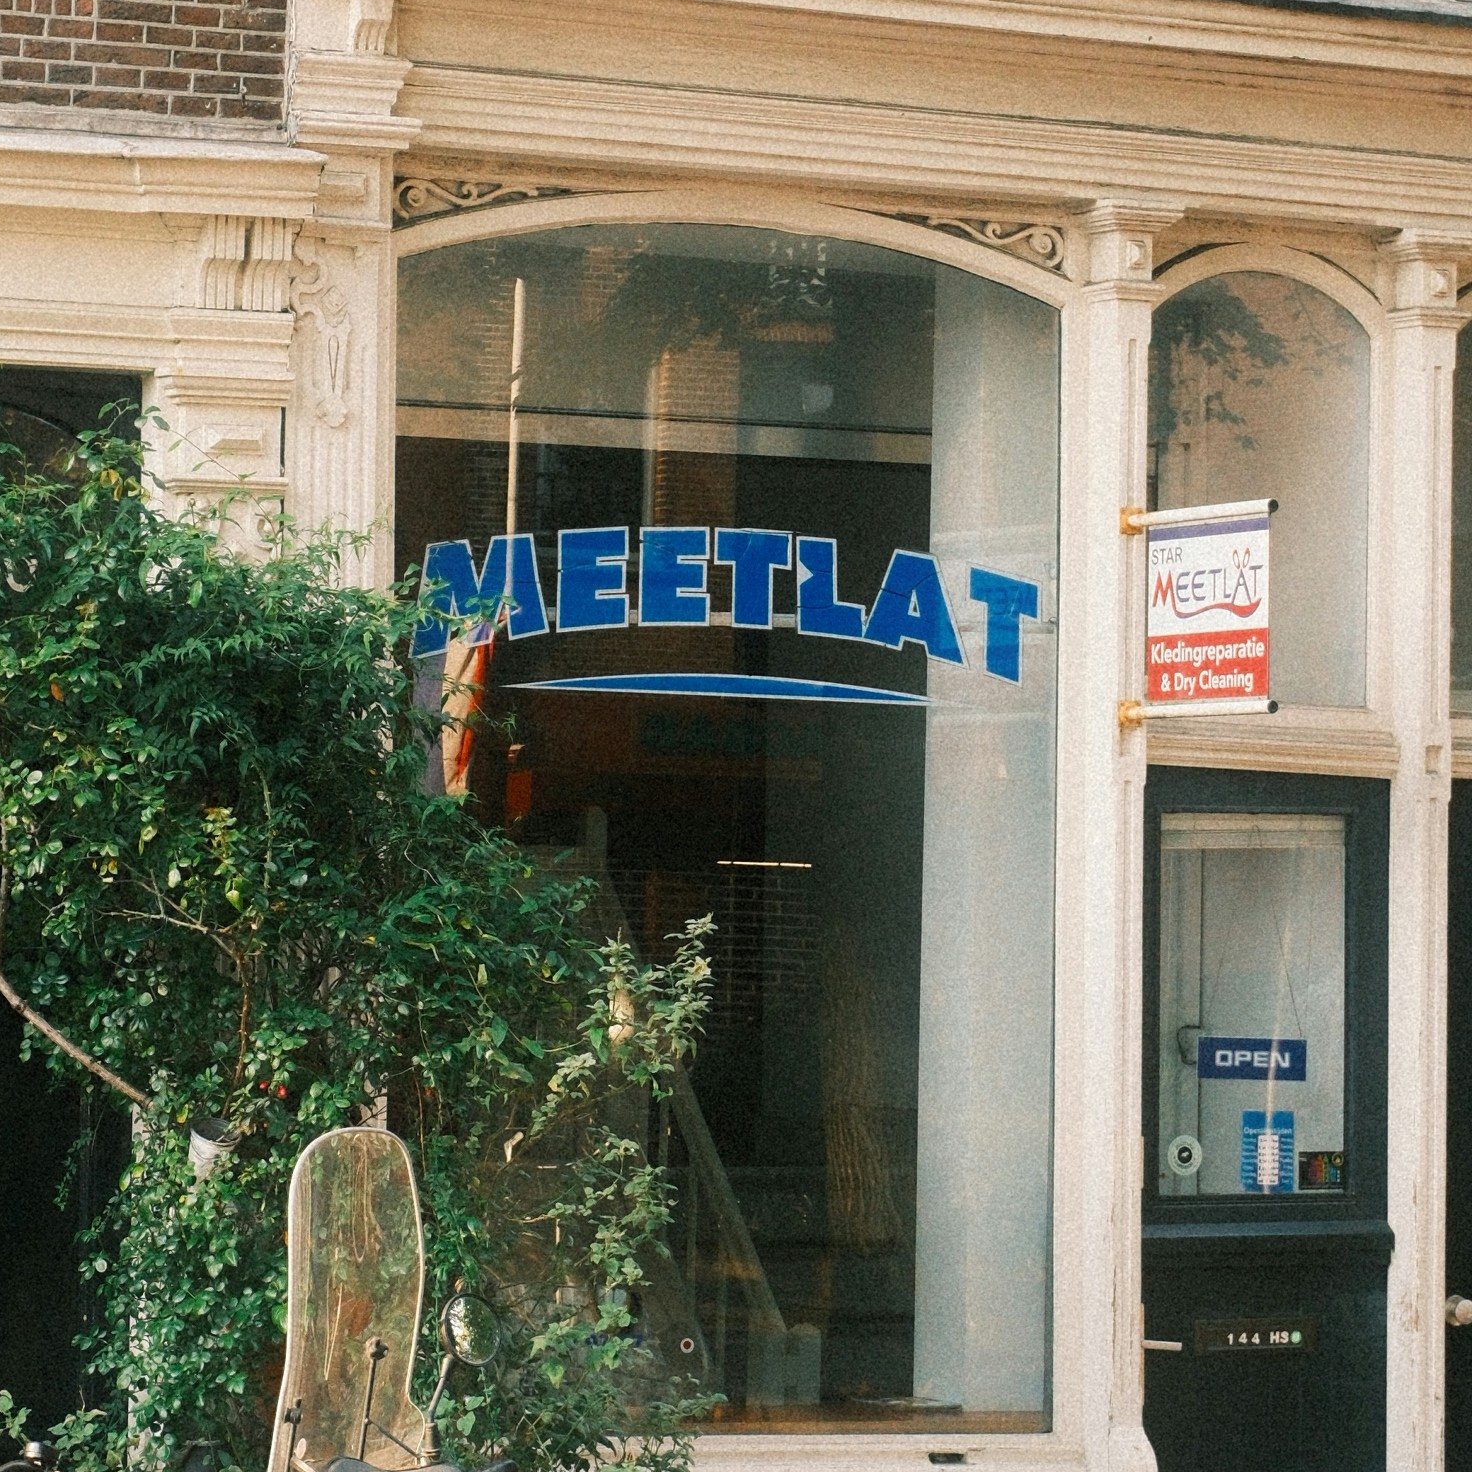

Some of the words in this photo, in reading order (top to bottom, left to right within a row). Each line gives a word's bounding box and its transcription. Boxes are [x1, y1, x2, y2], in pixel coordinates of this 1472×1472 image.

[1151, 547, 1183, 565] STAR
[1151, 564, 1264, 609] MEETLAT
[408, 526, 1042, 686] MEETLAT
[1151, 637, 1264, 666] Kledingreparatie
[1160, 672, 1171, 692] &
[1173, 673, 1197, 695] Dry
[1199, 669, 1253, 691] Cleaning
[1215, 1050, 1290, 1068] OPEN
[1227, 1332, 1260, 1345] 144
